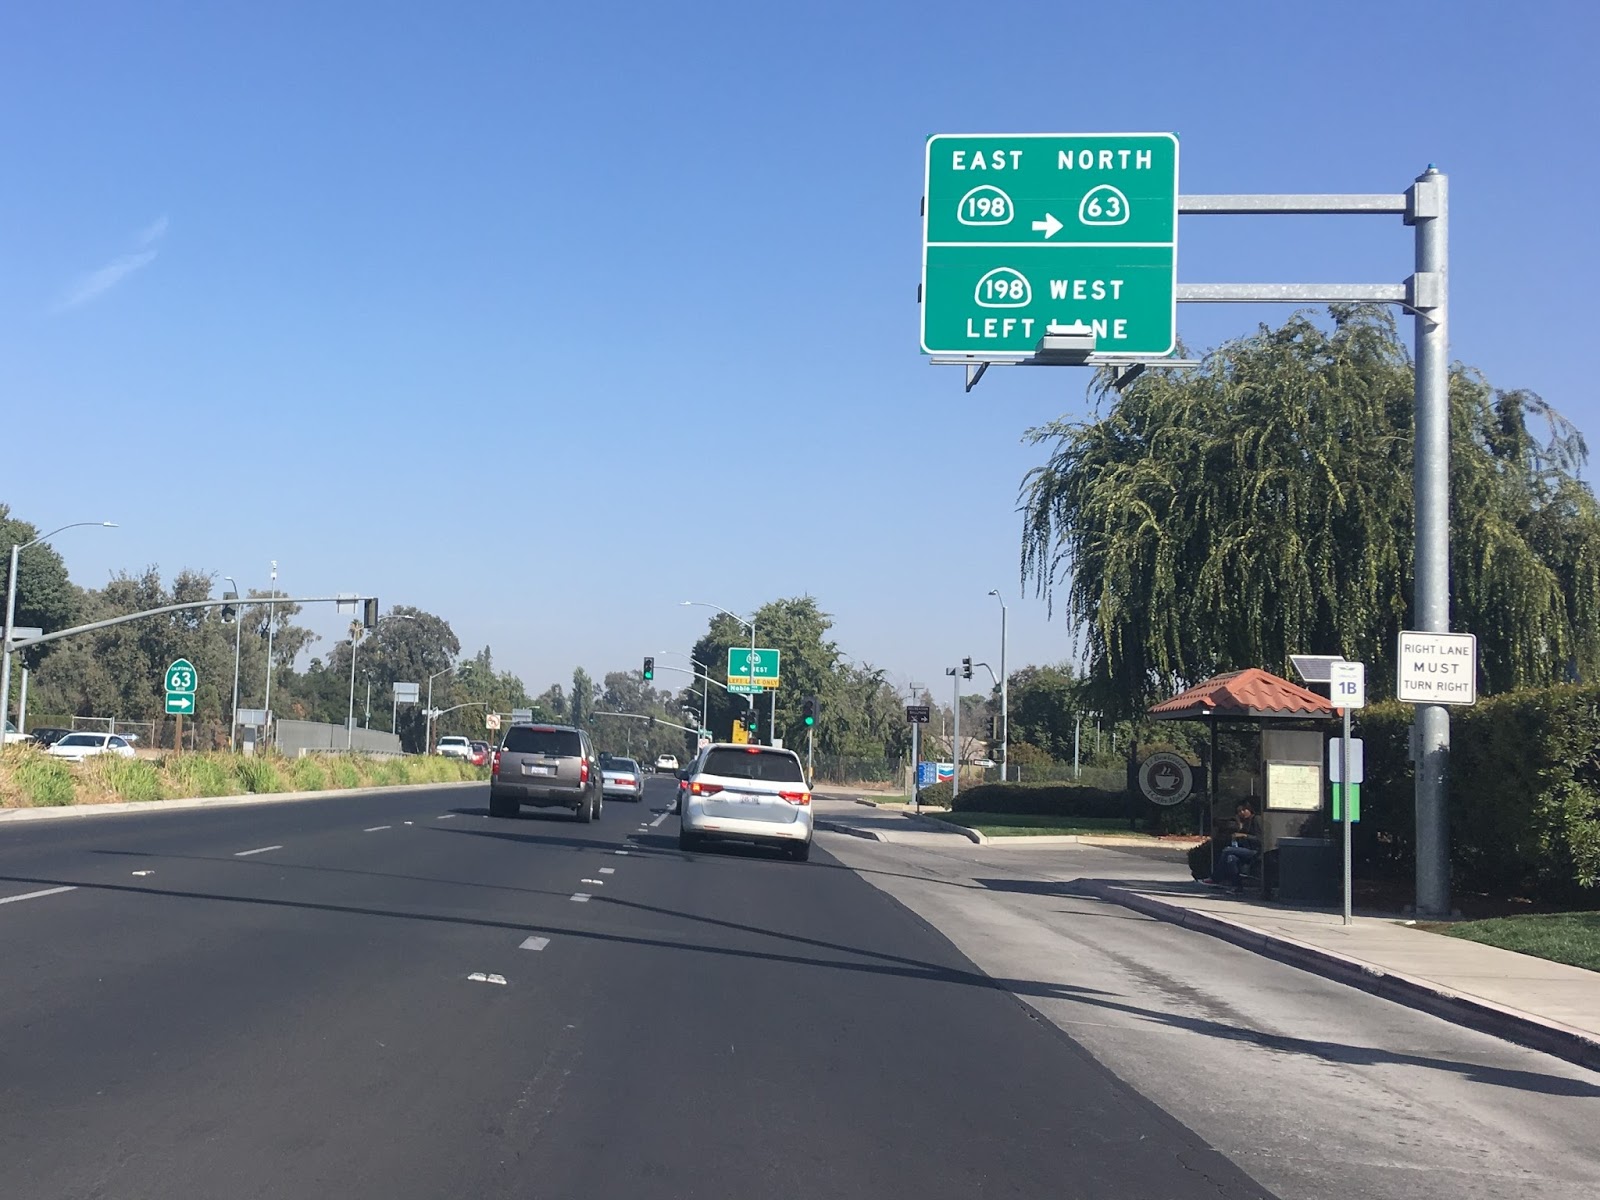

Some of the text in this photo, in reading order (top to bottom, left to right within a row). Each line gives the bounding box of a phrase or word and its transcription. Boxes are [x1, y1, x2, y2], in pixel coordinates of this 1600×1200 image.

[952, 149, 1152, 170] EAST NORTH
[968, 197, 1005, 217] 198
[1087, 197, 1120, 217] 63
[986, 279, 1124, 300] 198 WEST
[966, 318, 1035, 338] LEFT
[1404, 643, 1470, 656] RIGHT LANE
[1414, 662, 1459, 674] MUST
[171, 671, 191, 687] 63
[1338, 681, 1357, 695] 1B
[1404, 680, 1469, 692] TURN RIGHT
